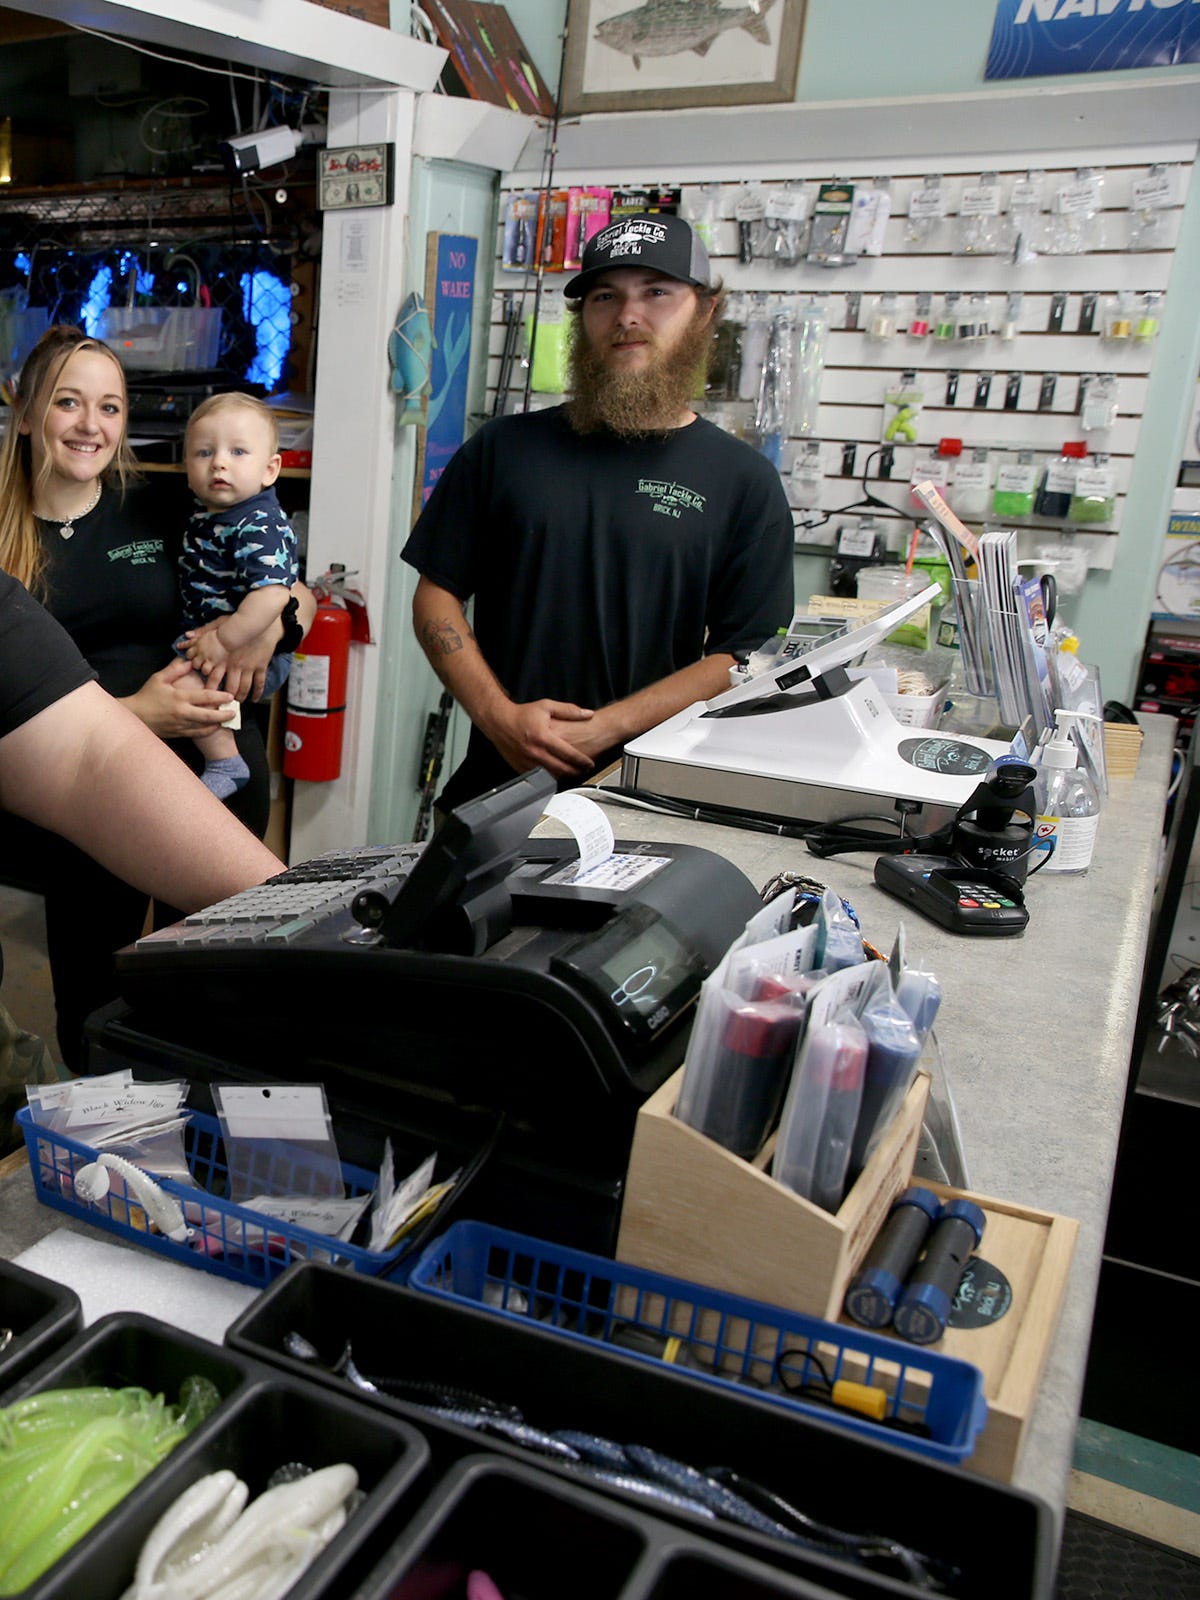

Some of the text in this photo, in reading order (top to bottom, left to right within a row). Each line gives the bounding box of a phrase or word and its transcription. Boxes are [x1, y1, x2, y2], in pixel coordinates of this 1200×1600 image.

[449, 252, 467, 269] NO
[441, 281, 471, 298] WAKE
[638, 482, 668, 493] Gabriel
[668, 486, 692, 501] Tackle
